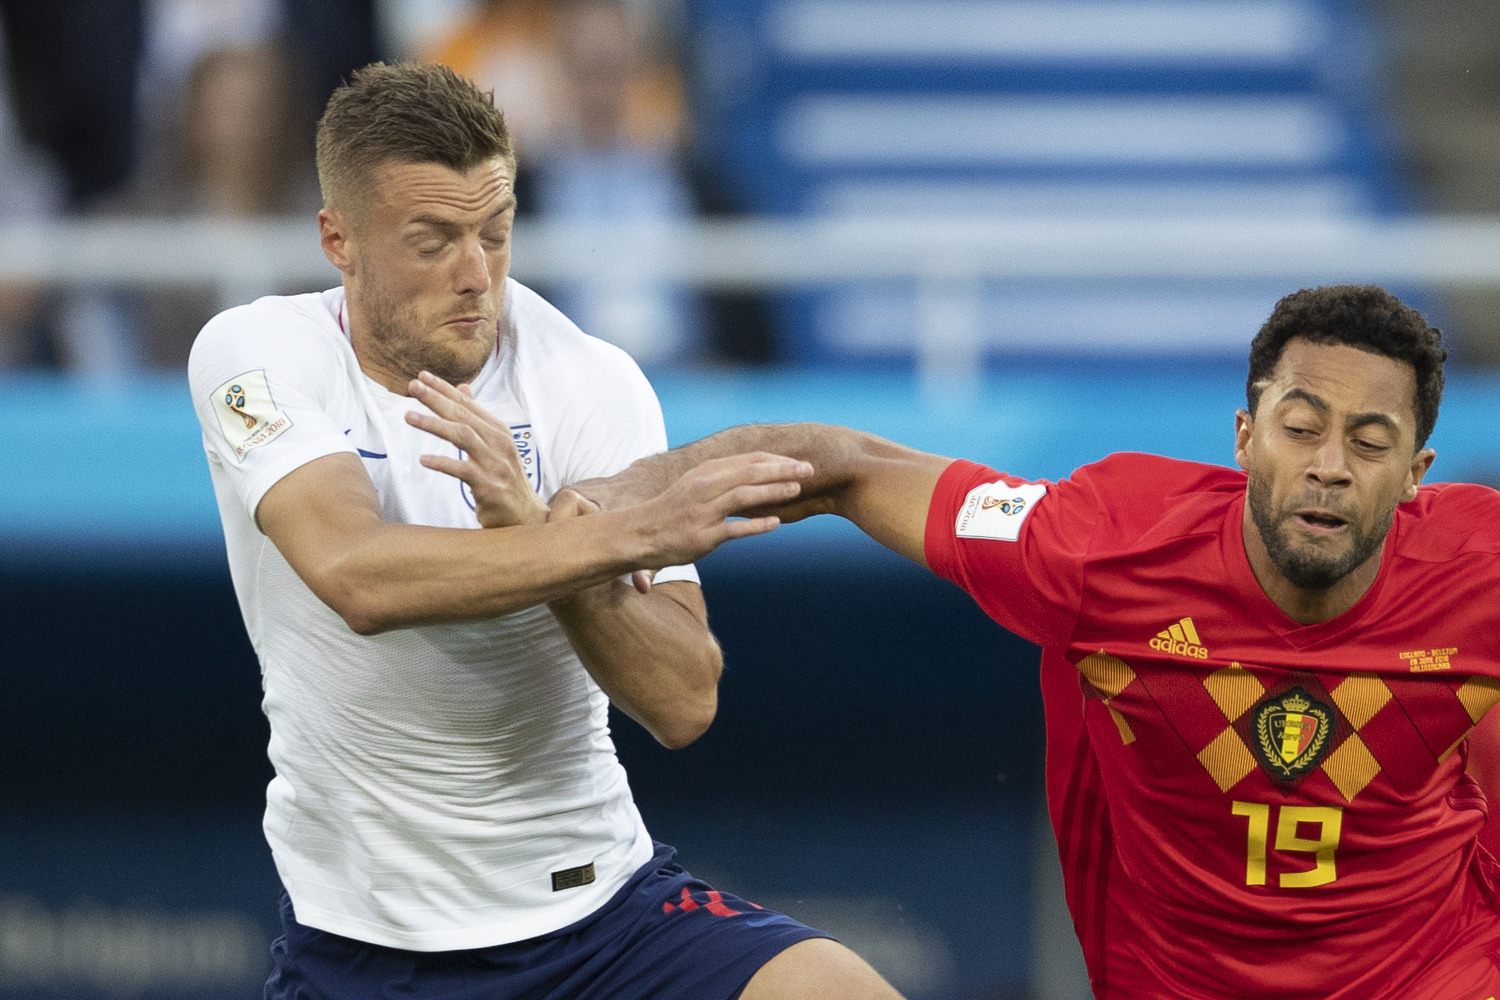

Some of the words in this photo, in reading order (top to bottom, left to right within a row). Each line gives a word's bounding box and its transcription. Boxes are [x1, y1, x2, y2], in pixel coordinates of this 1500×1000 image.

[1149, 637, 1208, 659] adidas
[1399, 650, 1426, 659] ENGLAND
[1431, 647, 1458, 656] BELGIUM
[1419, 656, 1434, 664] JUNE
[1434, 655, 1449, 663] 2018
[1231, 800, 1343, 888] 19
